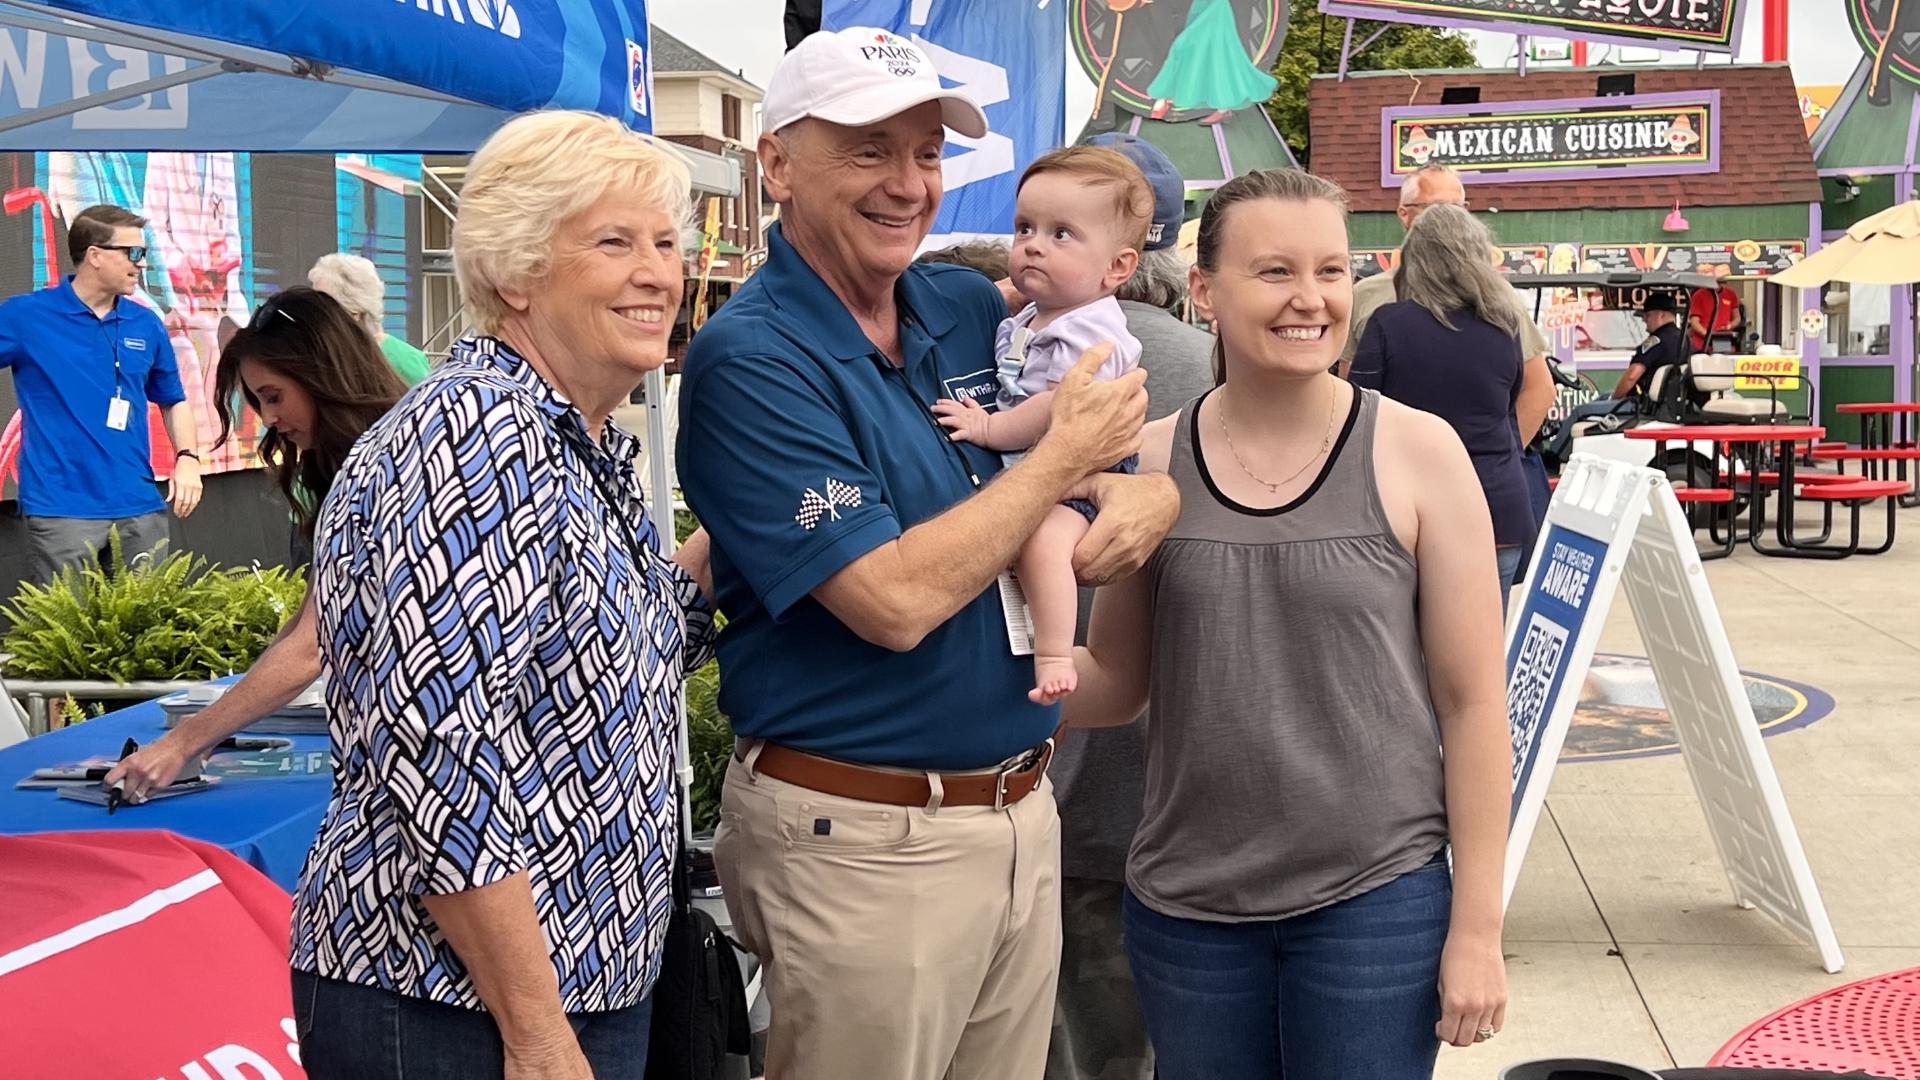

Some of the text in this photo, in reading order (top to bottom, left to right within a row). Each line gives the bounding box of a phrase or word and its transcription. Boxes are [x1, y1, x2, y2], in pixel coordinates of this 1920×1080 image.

[860, 46, 921, 63] PARIS
[1432, 120, 1669, 158] MEXICAN CUISINE
[1617, 287, 1688, 310] LOE
[1546, 312, 1585, 328] CORN
[1740, 361, 1794, 373] ORDER
[1744, 375, 1786, 385] HEE
[1552, 542, 1594, 573] STAY WEATHER
[1540, 559, 1590, 609] AWARE
